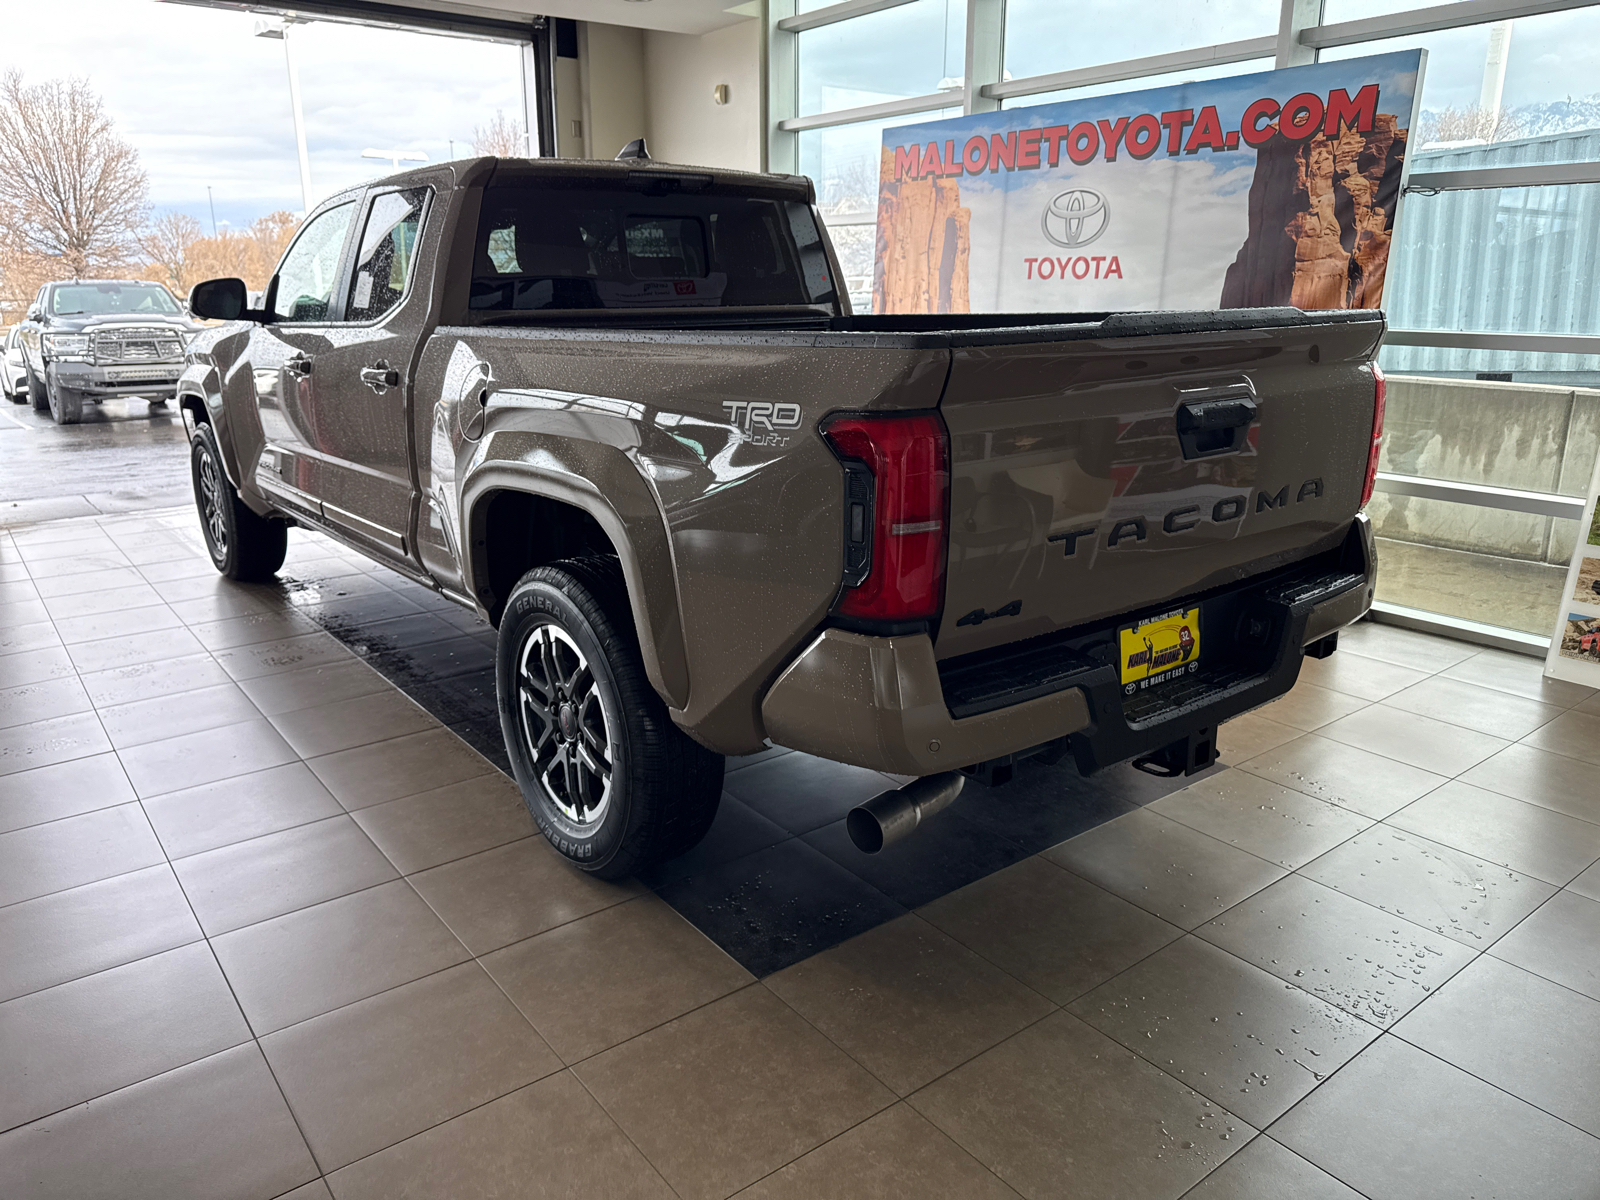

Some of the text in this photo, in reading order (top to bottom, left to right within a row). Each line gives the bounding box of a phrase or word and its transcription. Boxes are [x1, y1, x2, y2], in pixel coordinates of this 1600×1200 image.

[893, 83, 1380, 183] MALONETOYOTA.COM
[1023, 256, 1123, 281] TOYOTA
[722, 400, 802, 430] TRD
[1048, 477, 1325, 558] TACOMA
[515, 595, 570, 627] GENERAL
[1180, 630, 1190, 642] 32
[1127, 649, 1148, 669] KARL
[1151, 648, 1182, 670] MALONE
[1140, 667, 1186, 689] WE MAKE IT EASY
[537, 817, 592, 858] GRABBER
